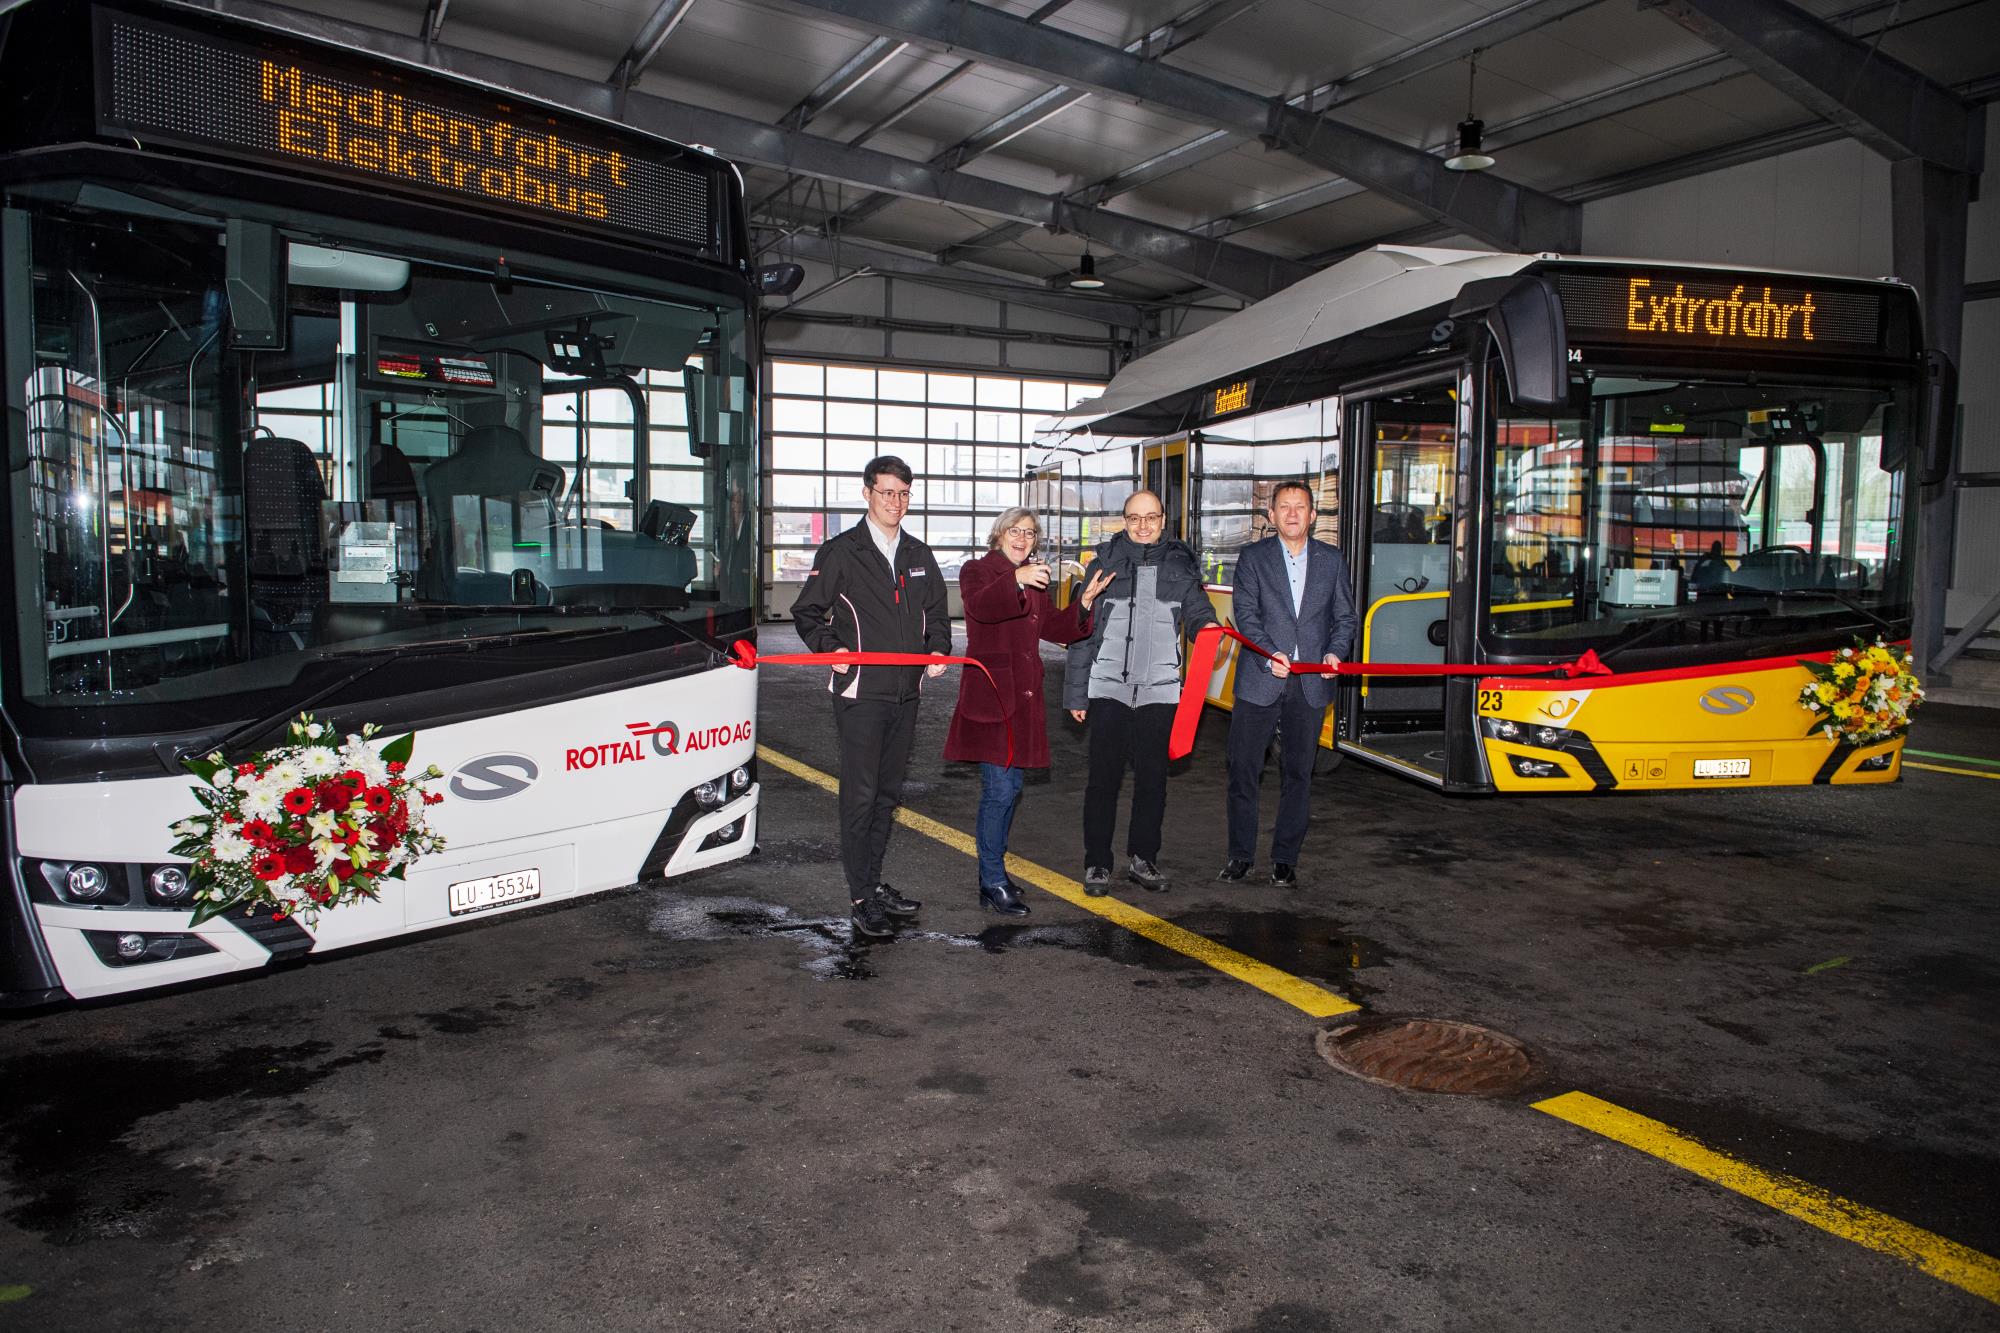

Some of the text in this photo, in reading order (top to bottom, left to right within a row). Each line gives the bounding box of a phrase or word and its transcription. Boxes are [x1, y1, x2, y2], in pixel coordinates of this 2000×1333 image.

[262, 60, 629, 188] Medienfahrt
[279, 108, 608, 218] Elektrobus
[1627, 278, 1816, 340] Extrafahrt
[1479, 690, 1503, 712] 23
[566, 740, 645, 771] ROTTAL
[685, 725, 731, 753] AUTO
[732, 720, 752, 743] AG
[1699, 761, 1747, 774] LU 15127
[457, 885, 476, 907] LU
[488, 874, 534, 900] 15534
